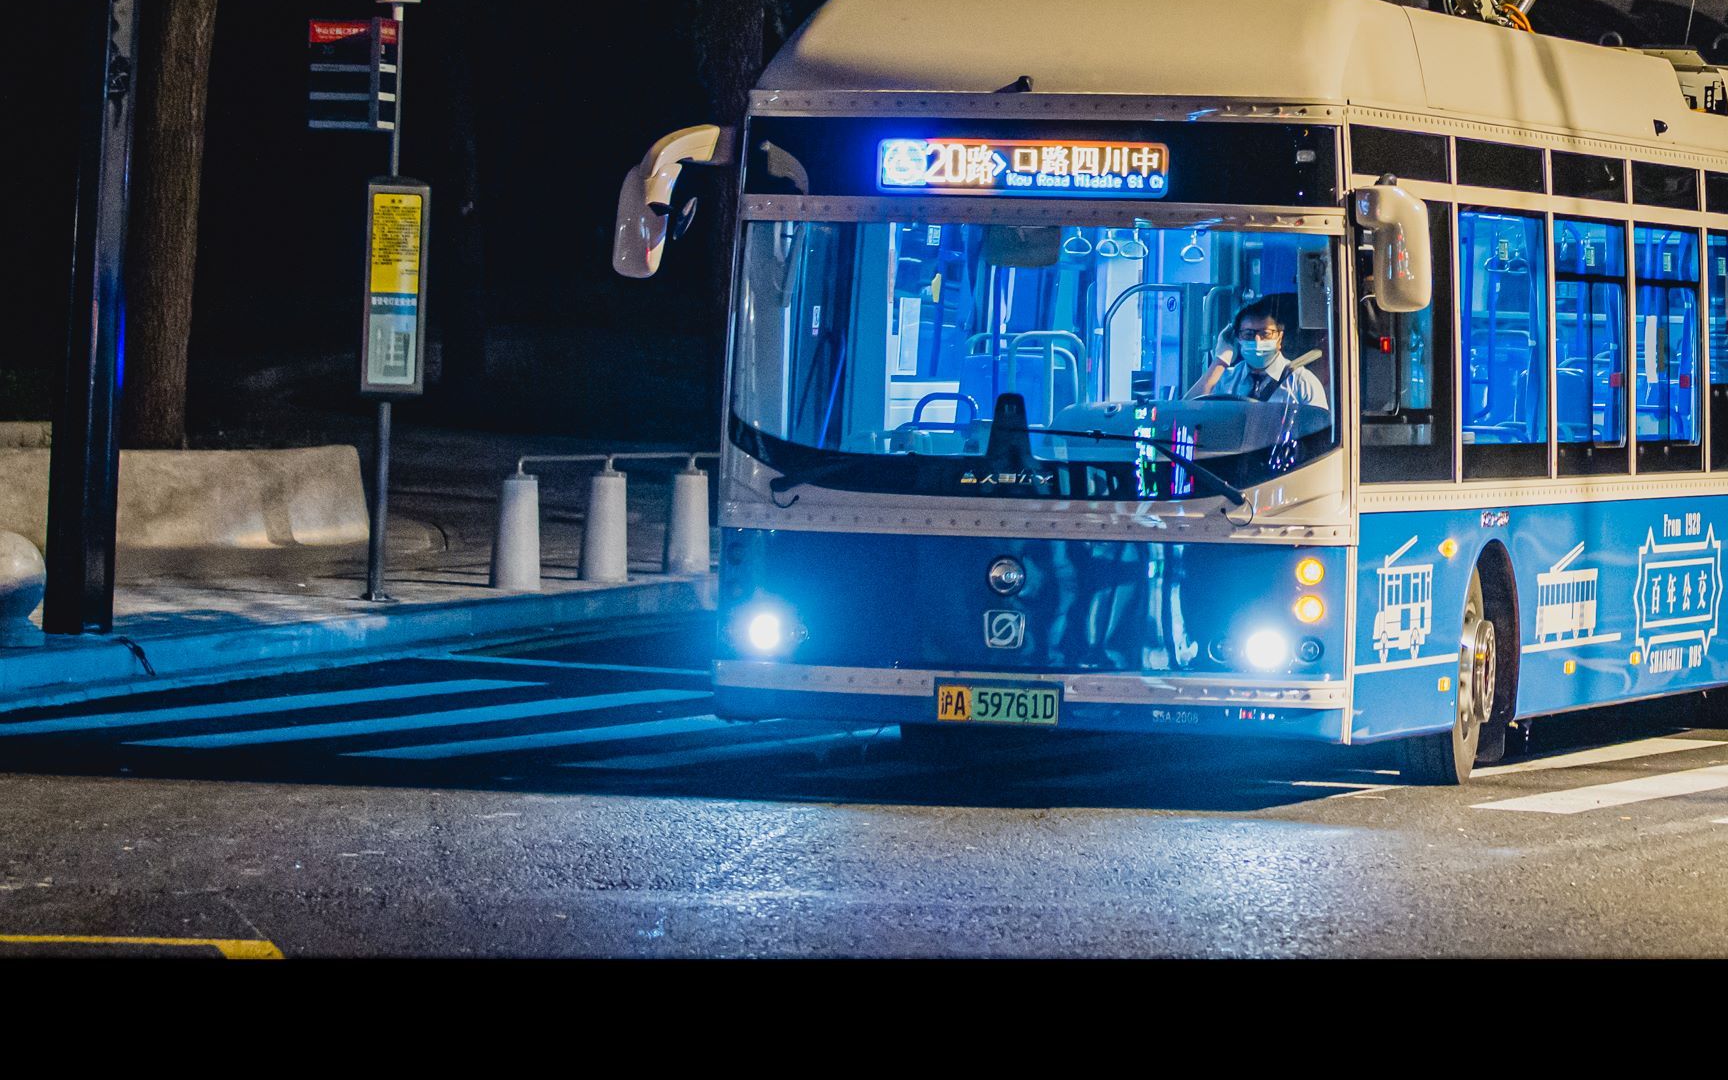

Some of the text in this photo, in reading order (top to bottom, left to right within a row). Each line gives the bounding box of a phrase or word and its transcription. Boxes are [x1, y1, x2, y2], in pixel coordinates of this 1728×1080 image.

[1013, 146, 1160, 178] 口路四川中
[1005, 172, 1032, 187] Kou
[1037, 173, 1070, 187] Road
[1074, 174, 1122, 189] Middle
[1127, 175, 1144, 189] Si
[1663, 513, 1682, 538] From
[1651, 570, 1708, 615] 百年公交
[1649, 644, 1702, 674] SHANGHAI BUS
[976, 690, 1056, 720] 59761D
